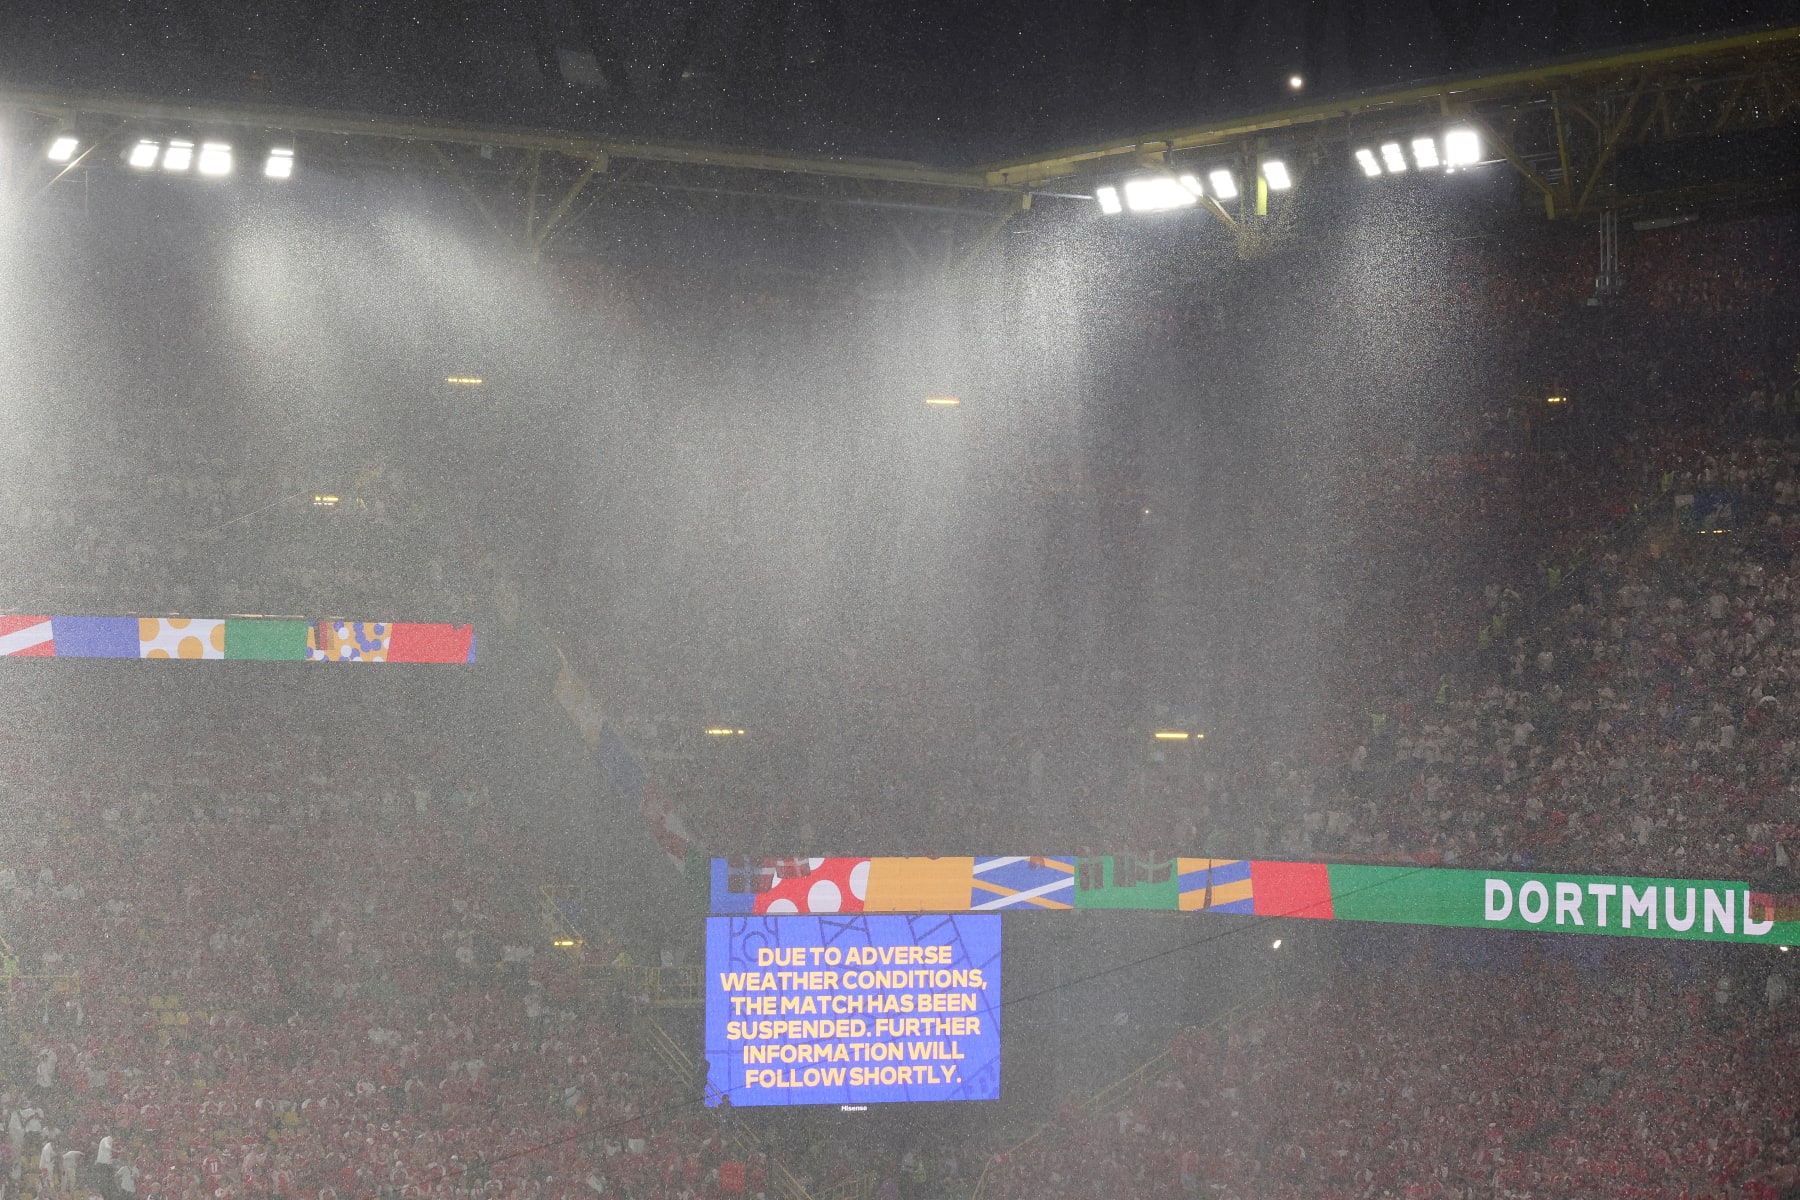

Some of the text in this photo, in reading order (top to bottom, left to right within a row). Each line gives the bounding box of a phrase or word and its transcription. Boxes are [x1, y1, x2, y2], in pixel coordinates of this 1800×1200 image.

[758, 945, 952, 967] DUE TO ADVERSE
[720, 969, 987, 991] WEATHER CONDITIONS,
[731, 993, 977, 1016] THE MATCH HAS BEEN
[727, 1017, 981, 1040] SUSPENDED. FURTHER
[743, 1041, 965, 1064] INFORMATION WILL
[746, 1065, 962, 1088] FOLLOW SHORTLY.
